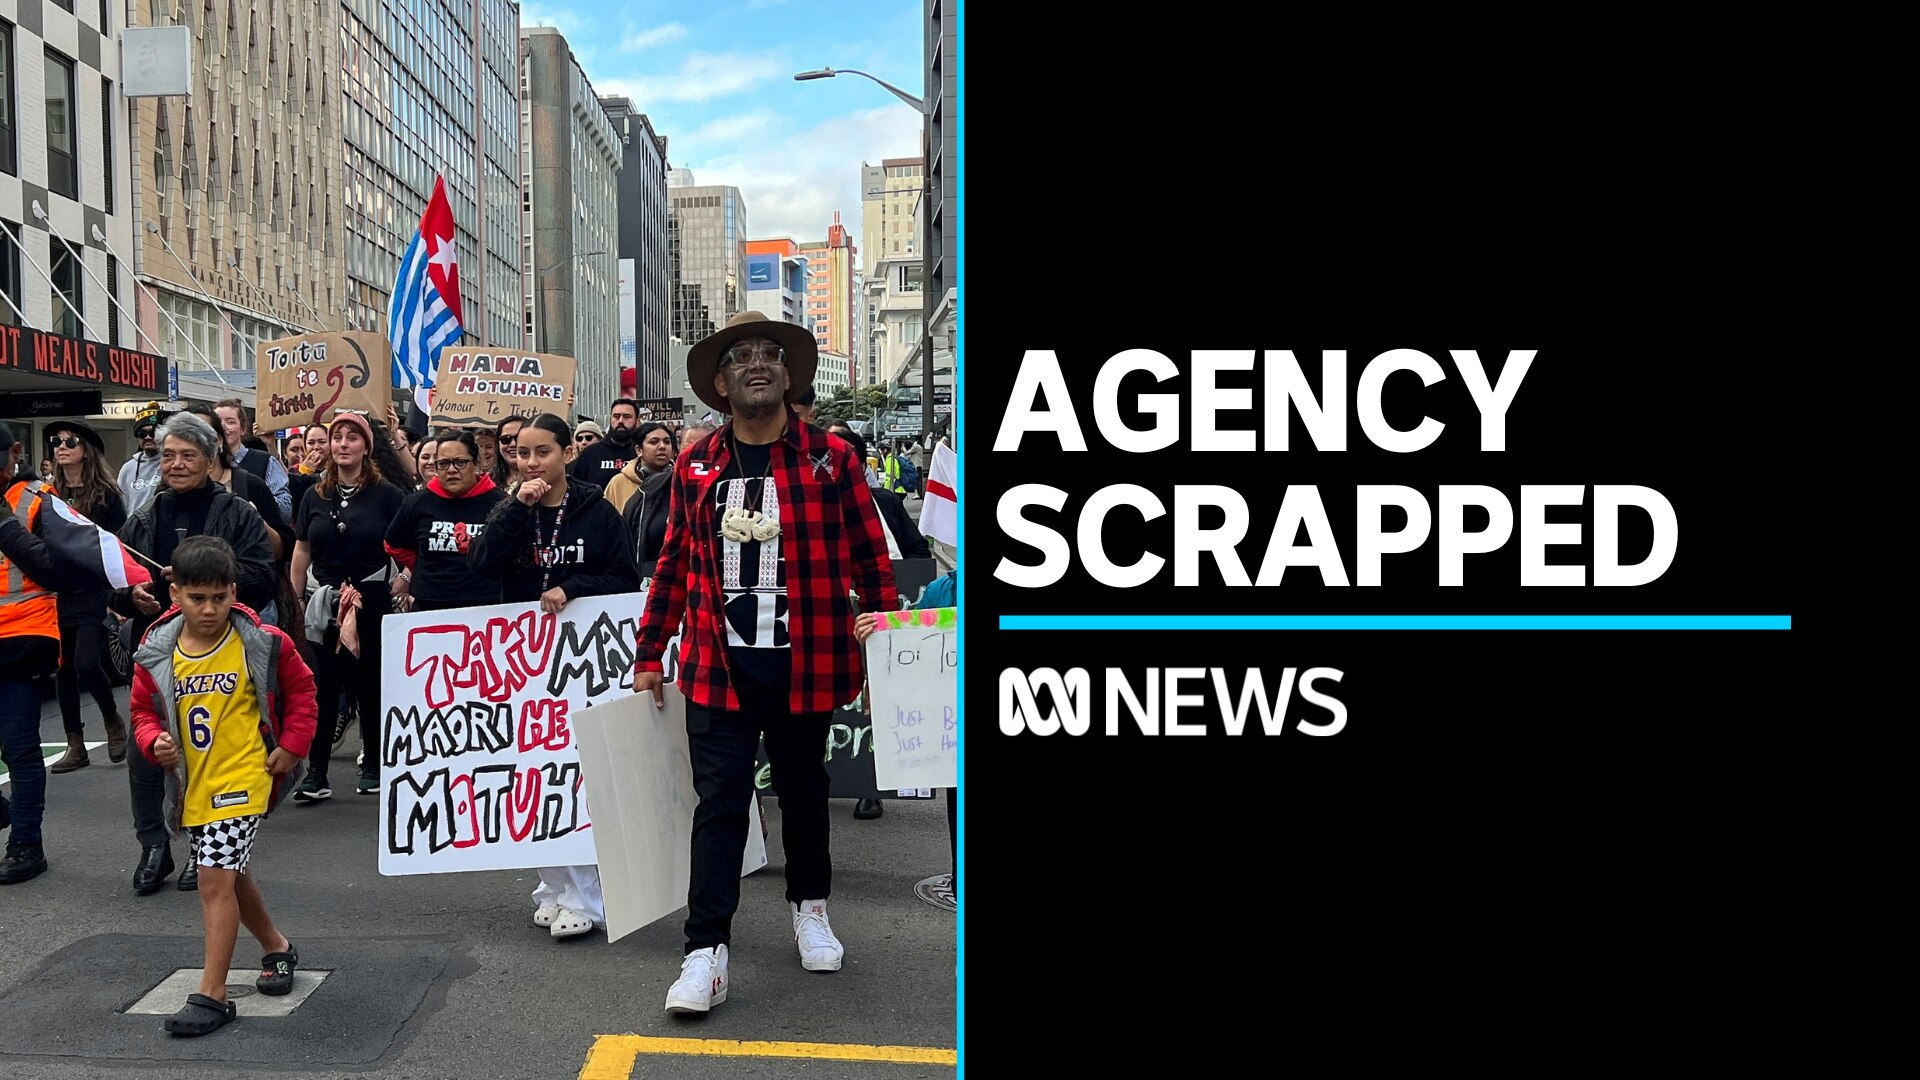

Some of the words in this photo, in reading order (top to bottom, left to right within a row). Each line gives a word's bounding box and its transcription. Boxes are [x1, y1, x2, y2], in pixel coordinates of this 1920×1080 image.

[190, 264, 274, 306] MANCHESTER
[33, 332, 103, 383] MEALS,
[109, 348, 156, 389] SUSHI
[449, 354, 543, 377] MANA
[296, 368, 318, 388] te
[456, 375, 564, 401] MOTUHAKE
[435, 399, 474, 412] Honour
[486, 400, 500, 415] Te
[647, 402, 672, 411] WILL
[654, 411, 683, 420] SPEAK
[406, 610, 557, 709] TAKU
[174, 672, 239, 703] AKERS
[187, 705, 213, 752] 6
[383, 702, 514, 767] MAORI
[517, 698, 570, 753] HE
[389, 762, 592, 856] MOTUH
